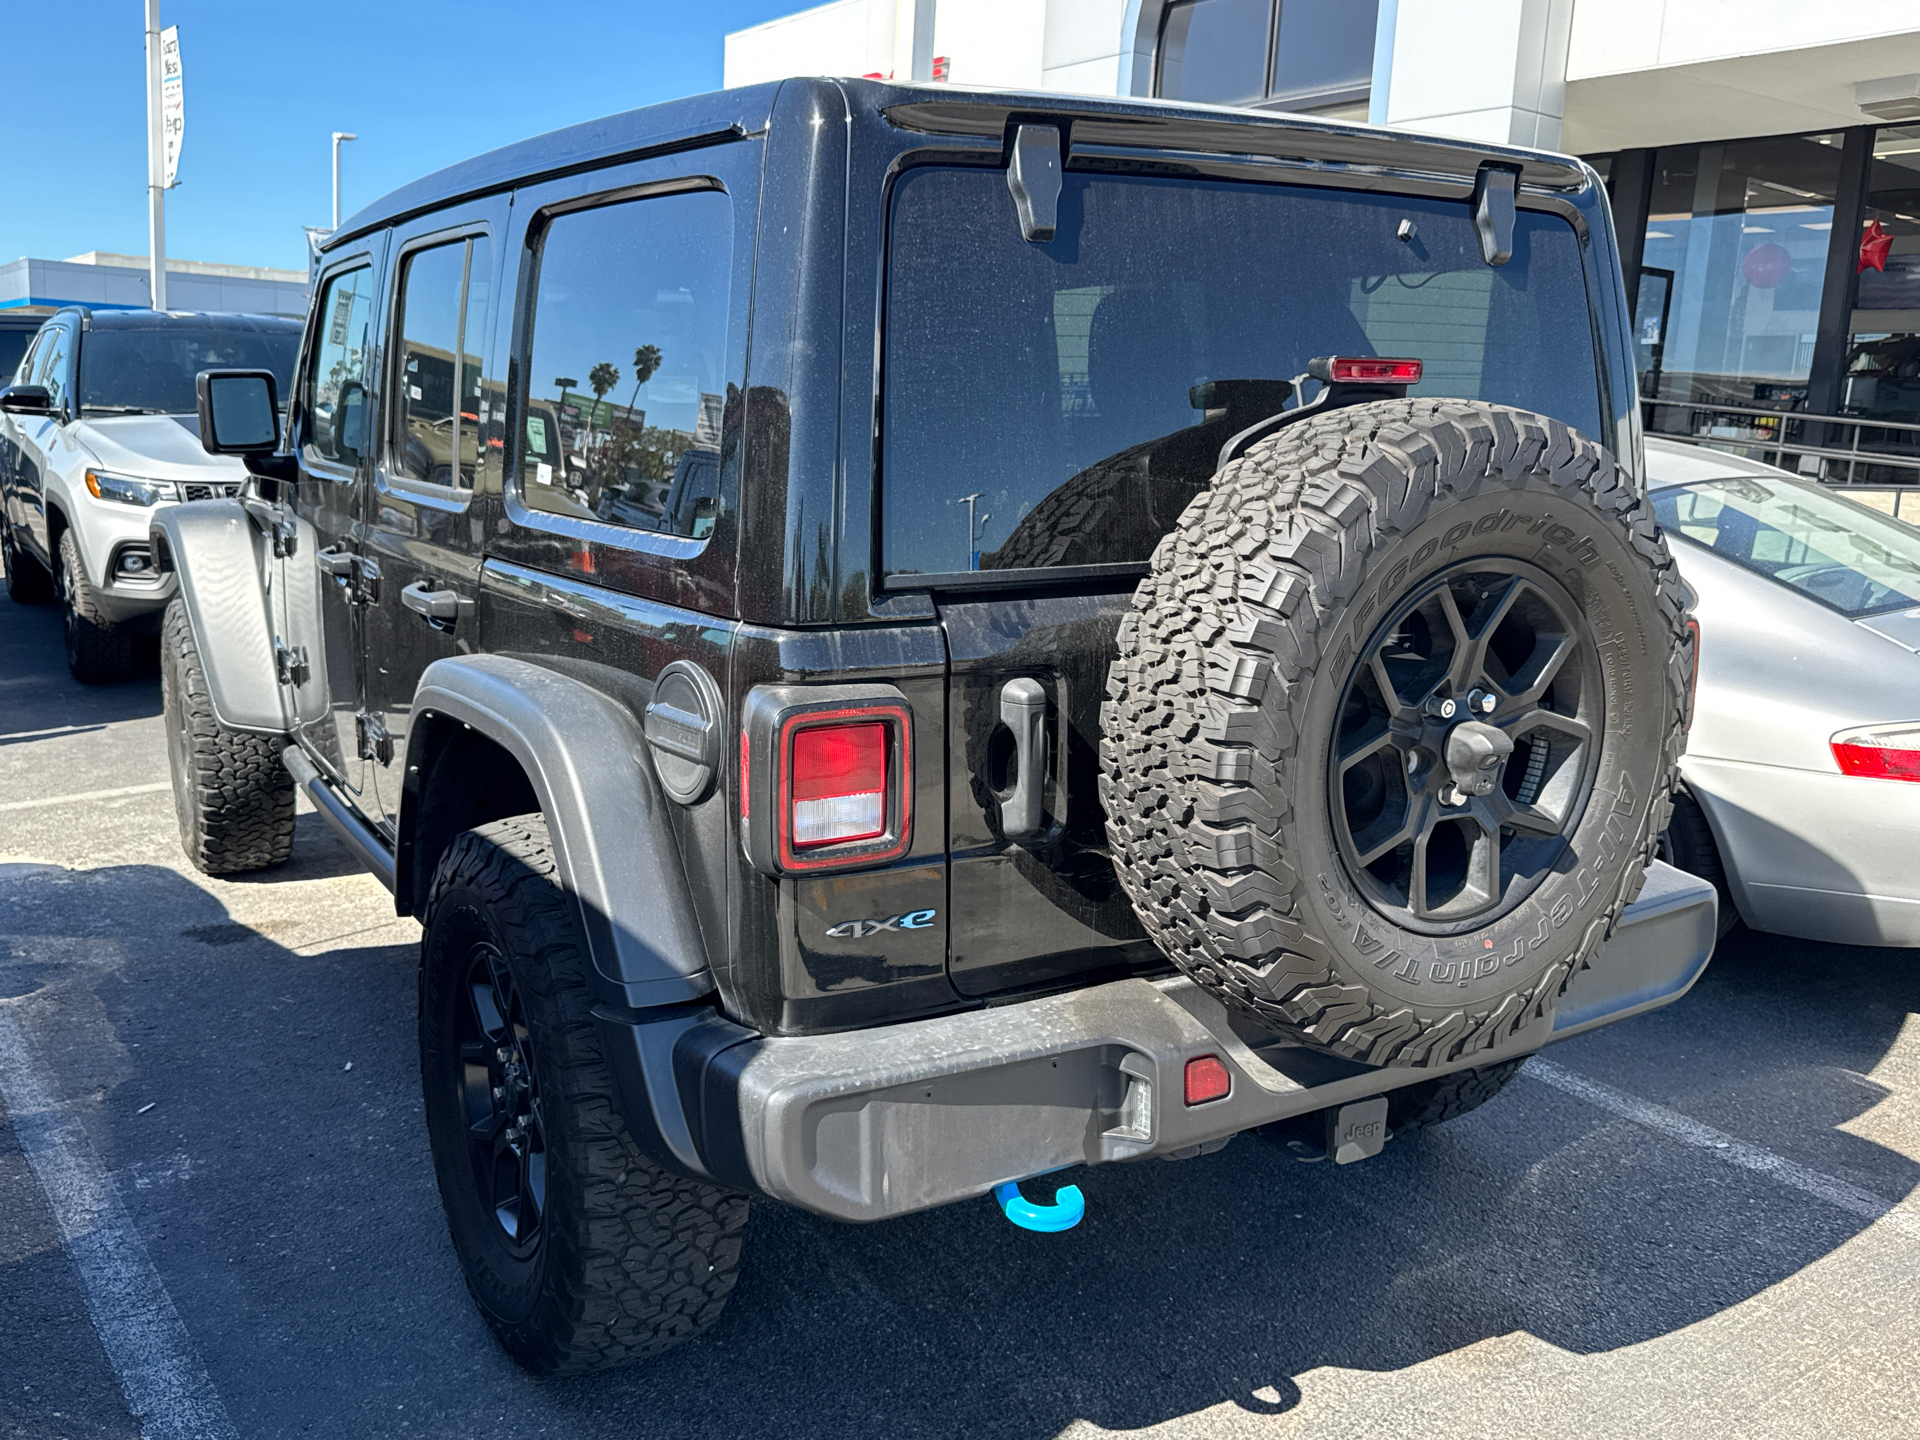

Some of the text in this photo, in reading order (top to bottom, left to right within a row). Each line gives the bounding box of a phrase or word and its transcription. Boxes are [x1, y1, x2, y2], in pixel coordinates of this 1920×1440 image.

[1329, 508, 1600, 689] BFGoodrich
[1428, 770, 1637, 988] All-Terrain
[1344, 1121, 1381, 1141] Jeep
